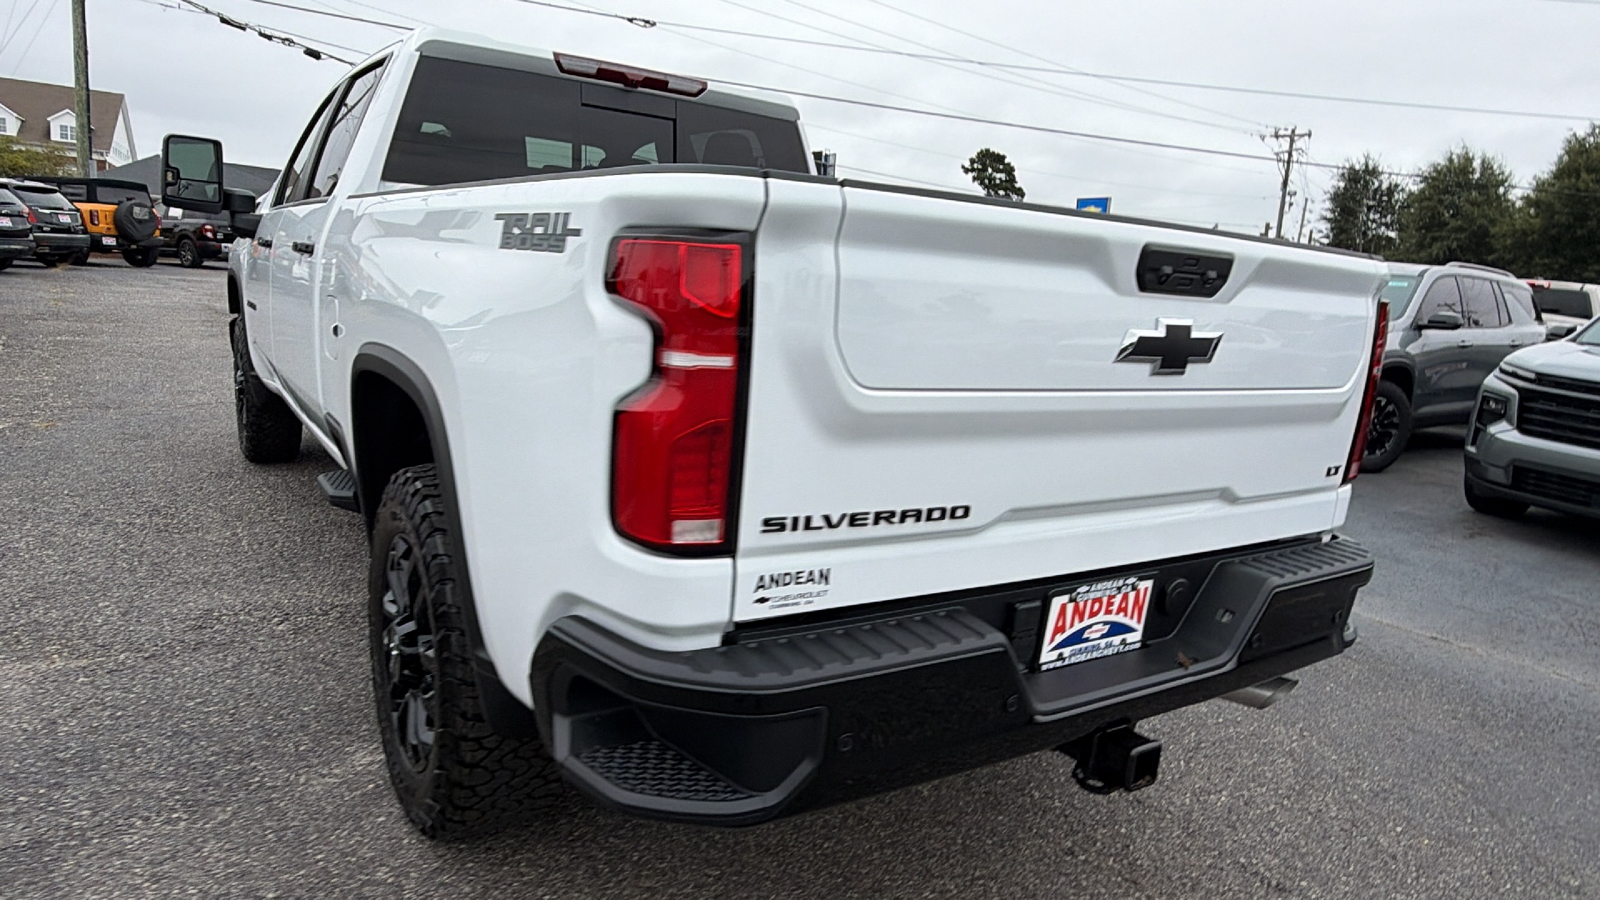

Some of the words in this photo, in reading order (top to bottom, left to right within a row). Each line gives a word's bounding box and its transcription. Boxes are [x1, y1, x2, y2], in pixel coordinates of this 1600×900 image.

[494, 212, 582, 236] TRAIL
[499, 233, 565, 253] BOSS
[1325, 465, 1342, 477] LT
[760, 505, 970, 533] SILVERADO
[753, 567, 831, 593] ANDEAN
[1048, 586, 1149, 646] ANDEAN
